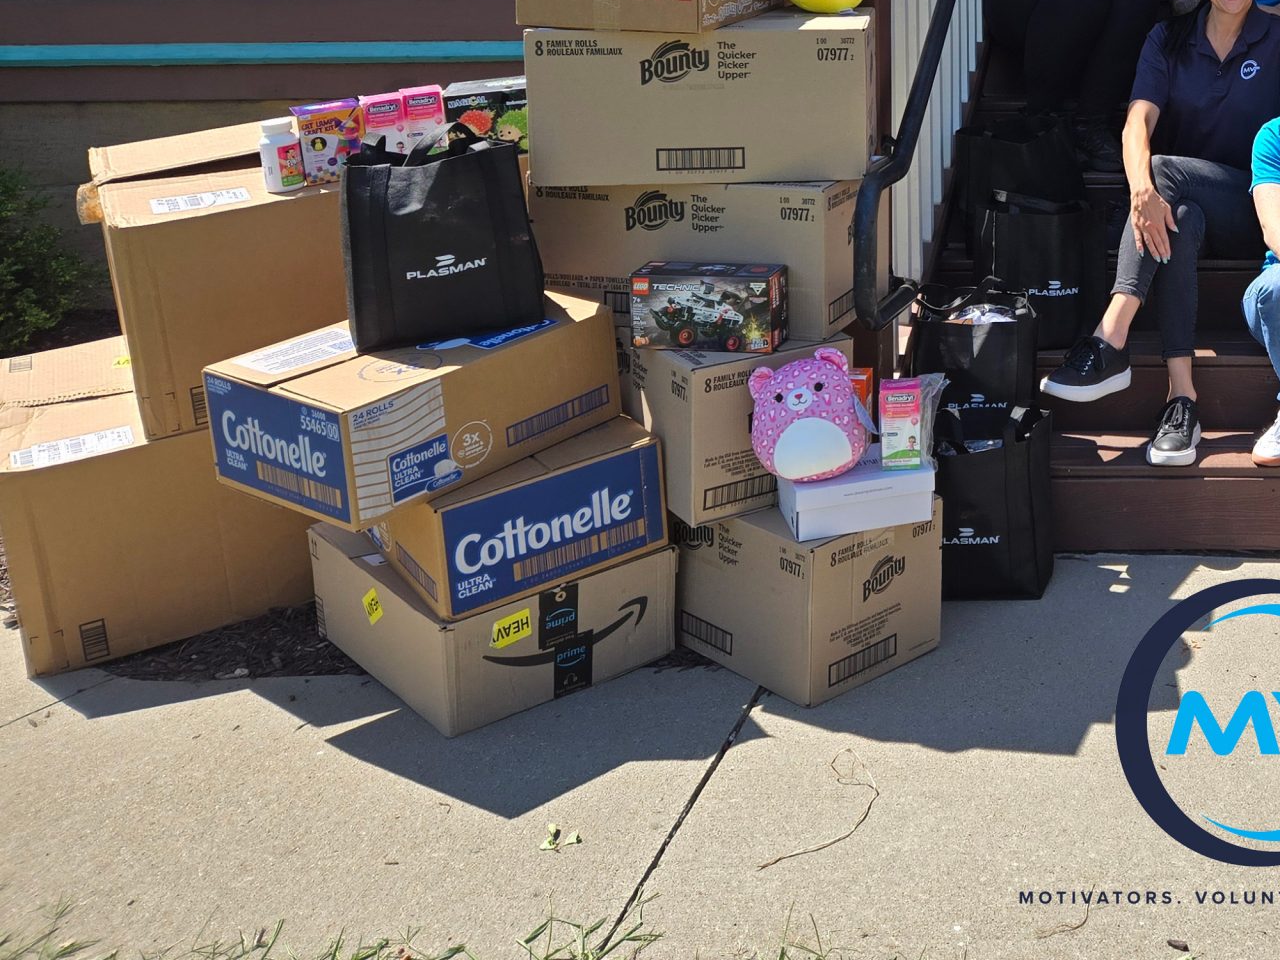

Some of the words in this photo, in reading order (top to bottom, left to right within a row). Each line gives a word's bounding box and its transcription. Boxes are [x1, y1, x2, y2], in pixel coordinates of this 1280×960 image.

[535, 40, 543, 57] 8
[546, 40, 573, 48] FAMILY
[575, 40, 598, 48] ROLLS
[717, 41, 736, 50] The
[547, 48, 584, 56] ROULEAUX
[586, 48, 623, 56] FAMILIAUX
[717, 51, 756, 60] Quicker
[817, 47, 849, 61] 07977
[639, 46, 709, 86] Bounty
[718, 61, 749, 69] Picker
[718, 71, 749, 80] Upper
[408, 96, 437, 105] Benadryl
[448, 96, 487, 109] MAGICAL
[301, 122, 314, 131] CAT
[315, 118, 336, 127] LAMP
[303, 128, 322, 136] CRAFT
[325, 124, 336, 132] KIT
[691, 194, 708, 203] The
[624, 199, 685, 231] Bounty
[691, 204, 726, 214] Quicker
[780, 207, 810, 222] 07977
[692, 213, 720, 223] Picker
[406, 257, 487, 280] PLASMAN
[632, 282, 648, 290] LEGO
[652, 283, 701, 291] TECHNIC
[1028, 287, 1079, 297] PLASMAN
[713, 372, 736, 384] FAMILY
[713, 379, 744, 391] ROULEAUX
[704, 378, 712, 393] 8
[887, 394, 914, 402] Benadryl
[352, 412, 364, 423] 24
[366, 401, 394, 417] ROLLS
[948, 401, 1007, 410] PLASMAN
[300, 416, 326, 436] 55465
[222, 410, 327, 478] Cottonelle
[463, 432, 480, 446] 3x
[226, 448, 245, 462] ULTRA
[392, 441, 447, 472] Cottonelle
[227, 458, 248, 471] CLEAN
[394, 466, 419, 480] ULTRA
[394, 471, 421, 487] CLEAN
[455, 487, 633, 575] Cottonelle
[941, 535, 1000, 545] LASMAN
[780, 556, 801, 578] 07977
[830, 553, 837, 568] 8
[458, 573, 490, 591] ULTRA
[863, 556, 905, 602] Bounty
[458, 580, 493, 599] CLEAN
[546, 613, 575, 629] prime
[492, 615, 529, 643] HEAV
[556, 645, 586, 664] prime
